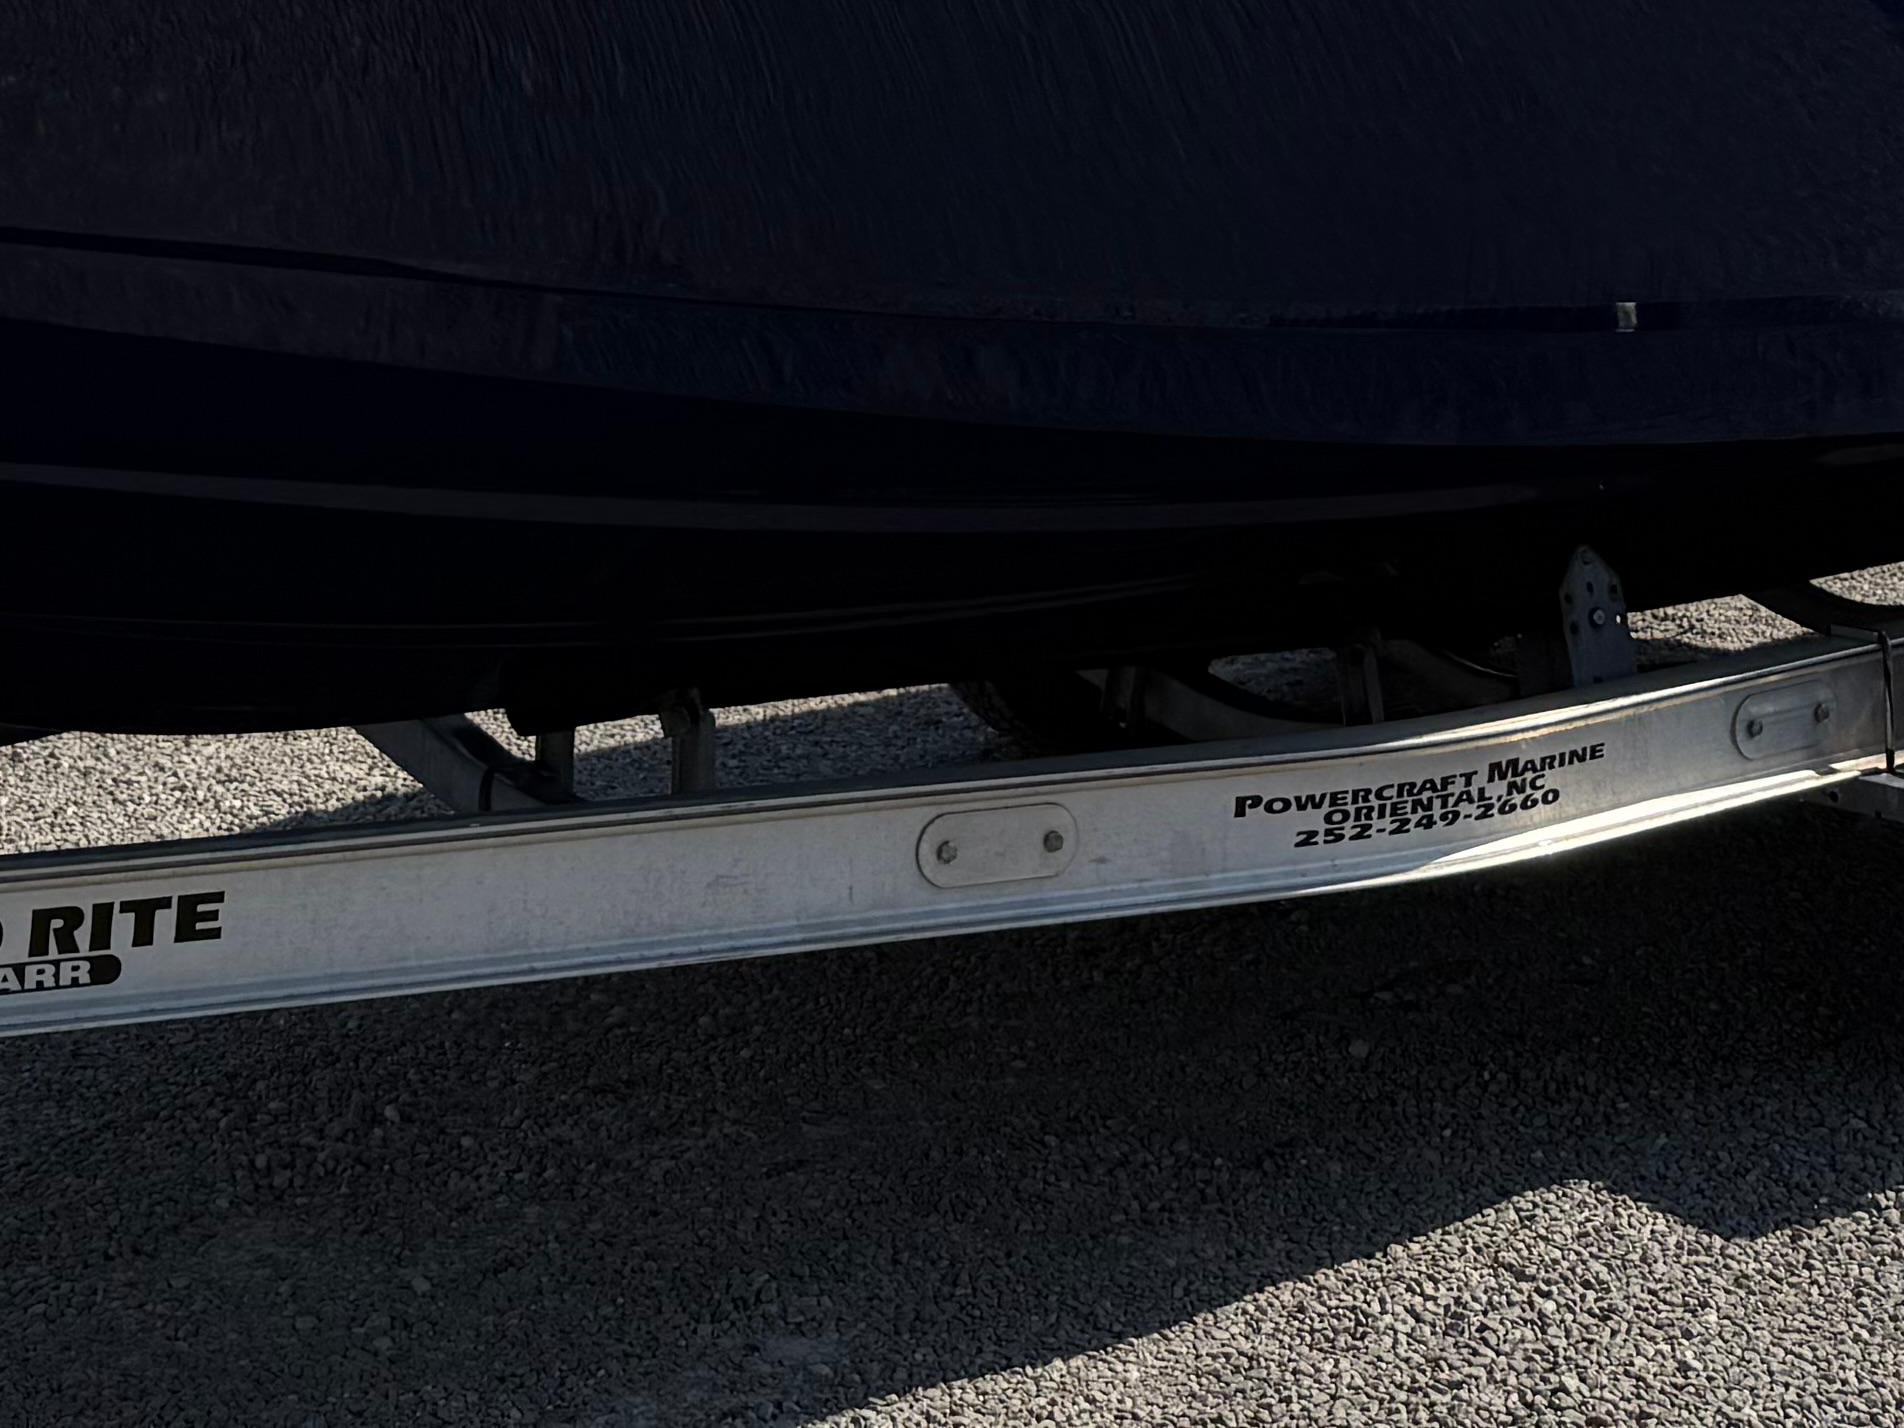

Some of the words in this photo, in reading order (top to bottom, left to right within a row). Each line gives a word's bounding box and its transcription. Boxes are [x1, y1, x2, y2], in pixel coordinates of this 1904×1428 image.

[1233, 770, 1479, 818] POWERCRAFT
[1486, 742, 1606, 784] MARINE
[1293, 787, 1561, 848] 252-249-2660
[27, 890, 226, 957] RITE
